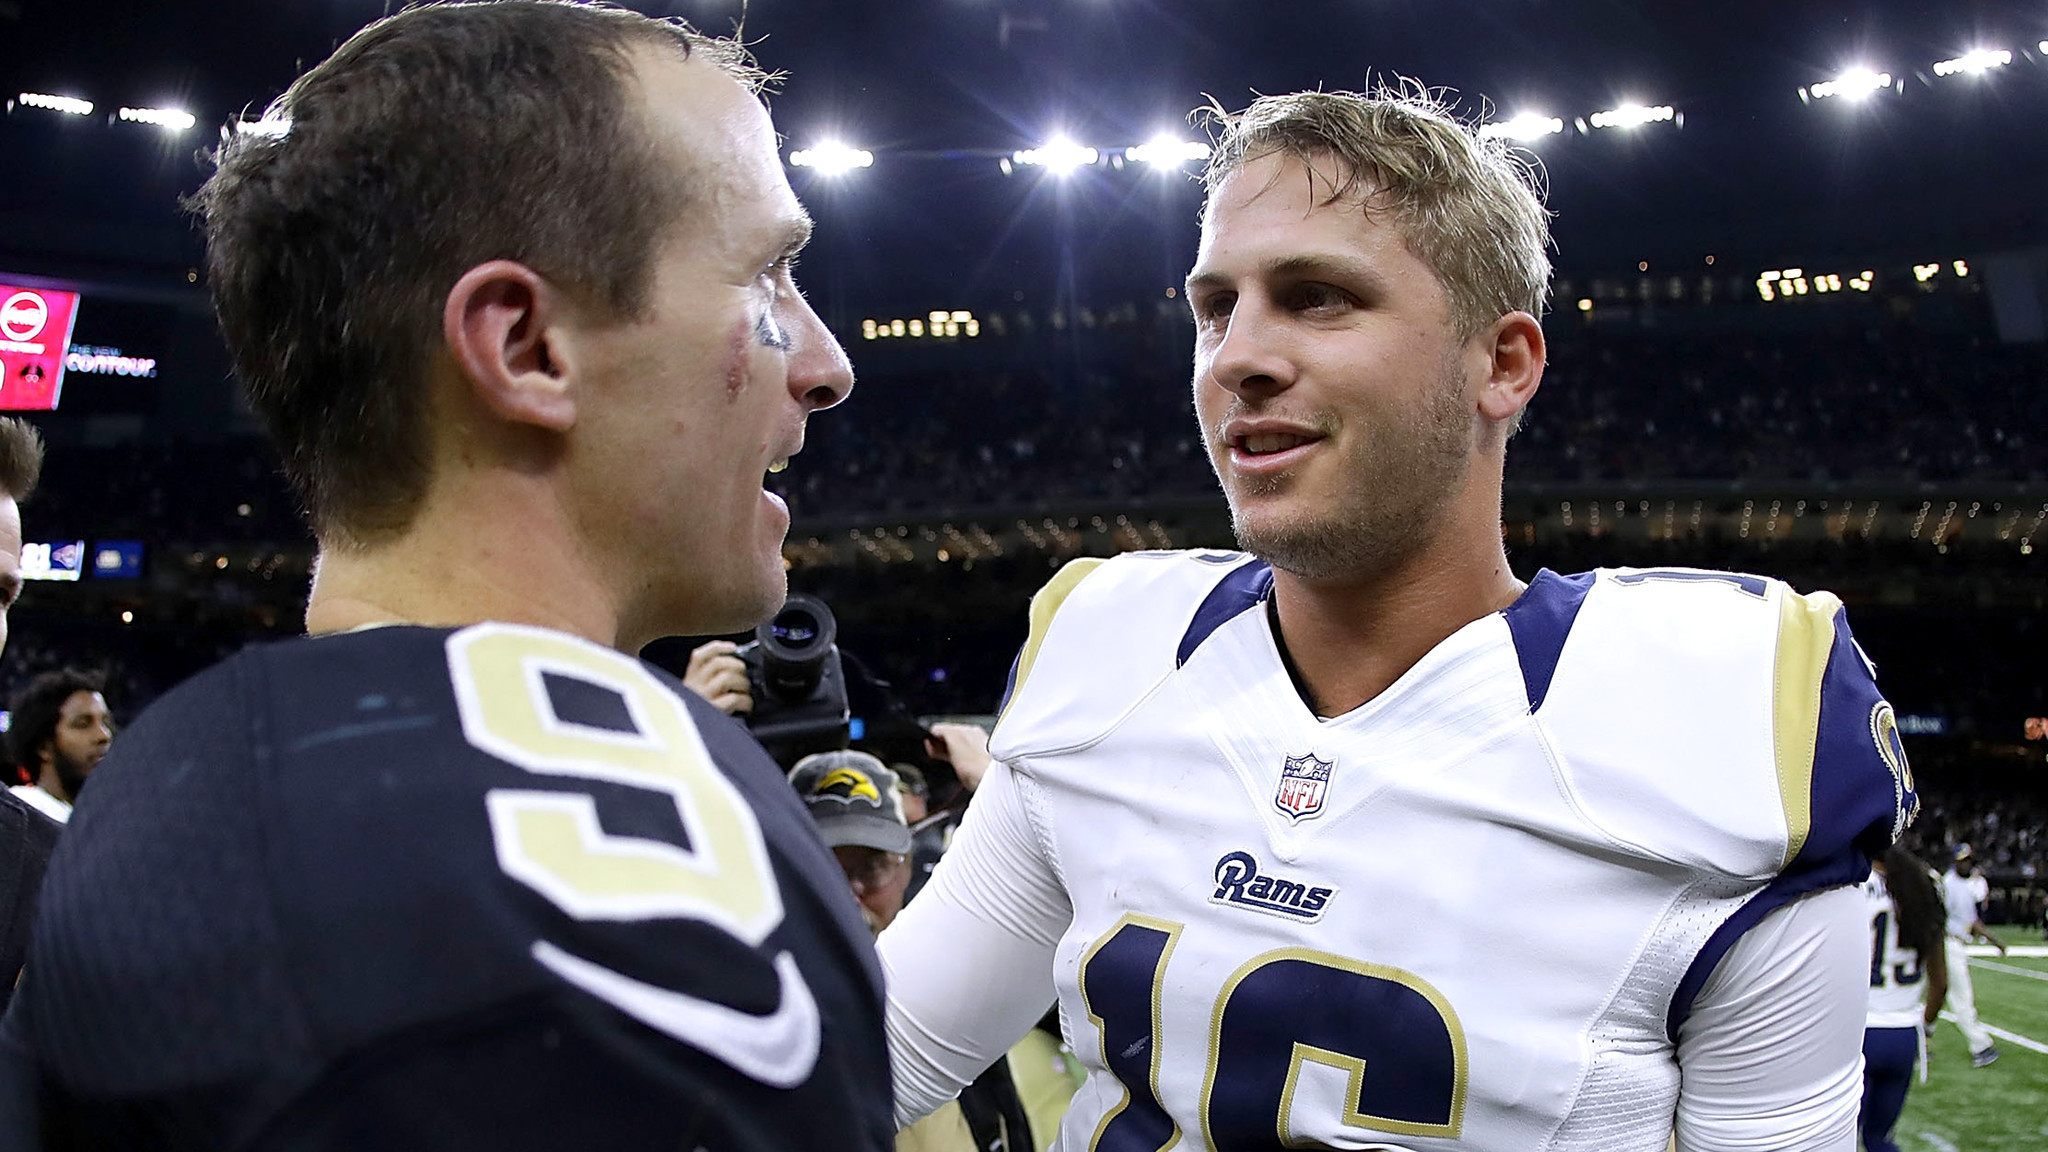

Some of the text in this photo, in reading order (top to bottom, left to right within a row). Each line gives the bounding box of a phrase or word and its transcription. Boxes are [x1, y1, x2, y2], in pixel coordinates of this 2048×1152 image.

[445, 621, 786, 948] 9
[1280, 779, 1319, 811] NFL
[1213, 851, 1333, 917] Rams
